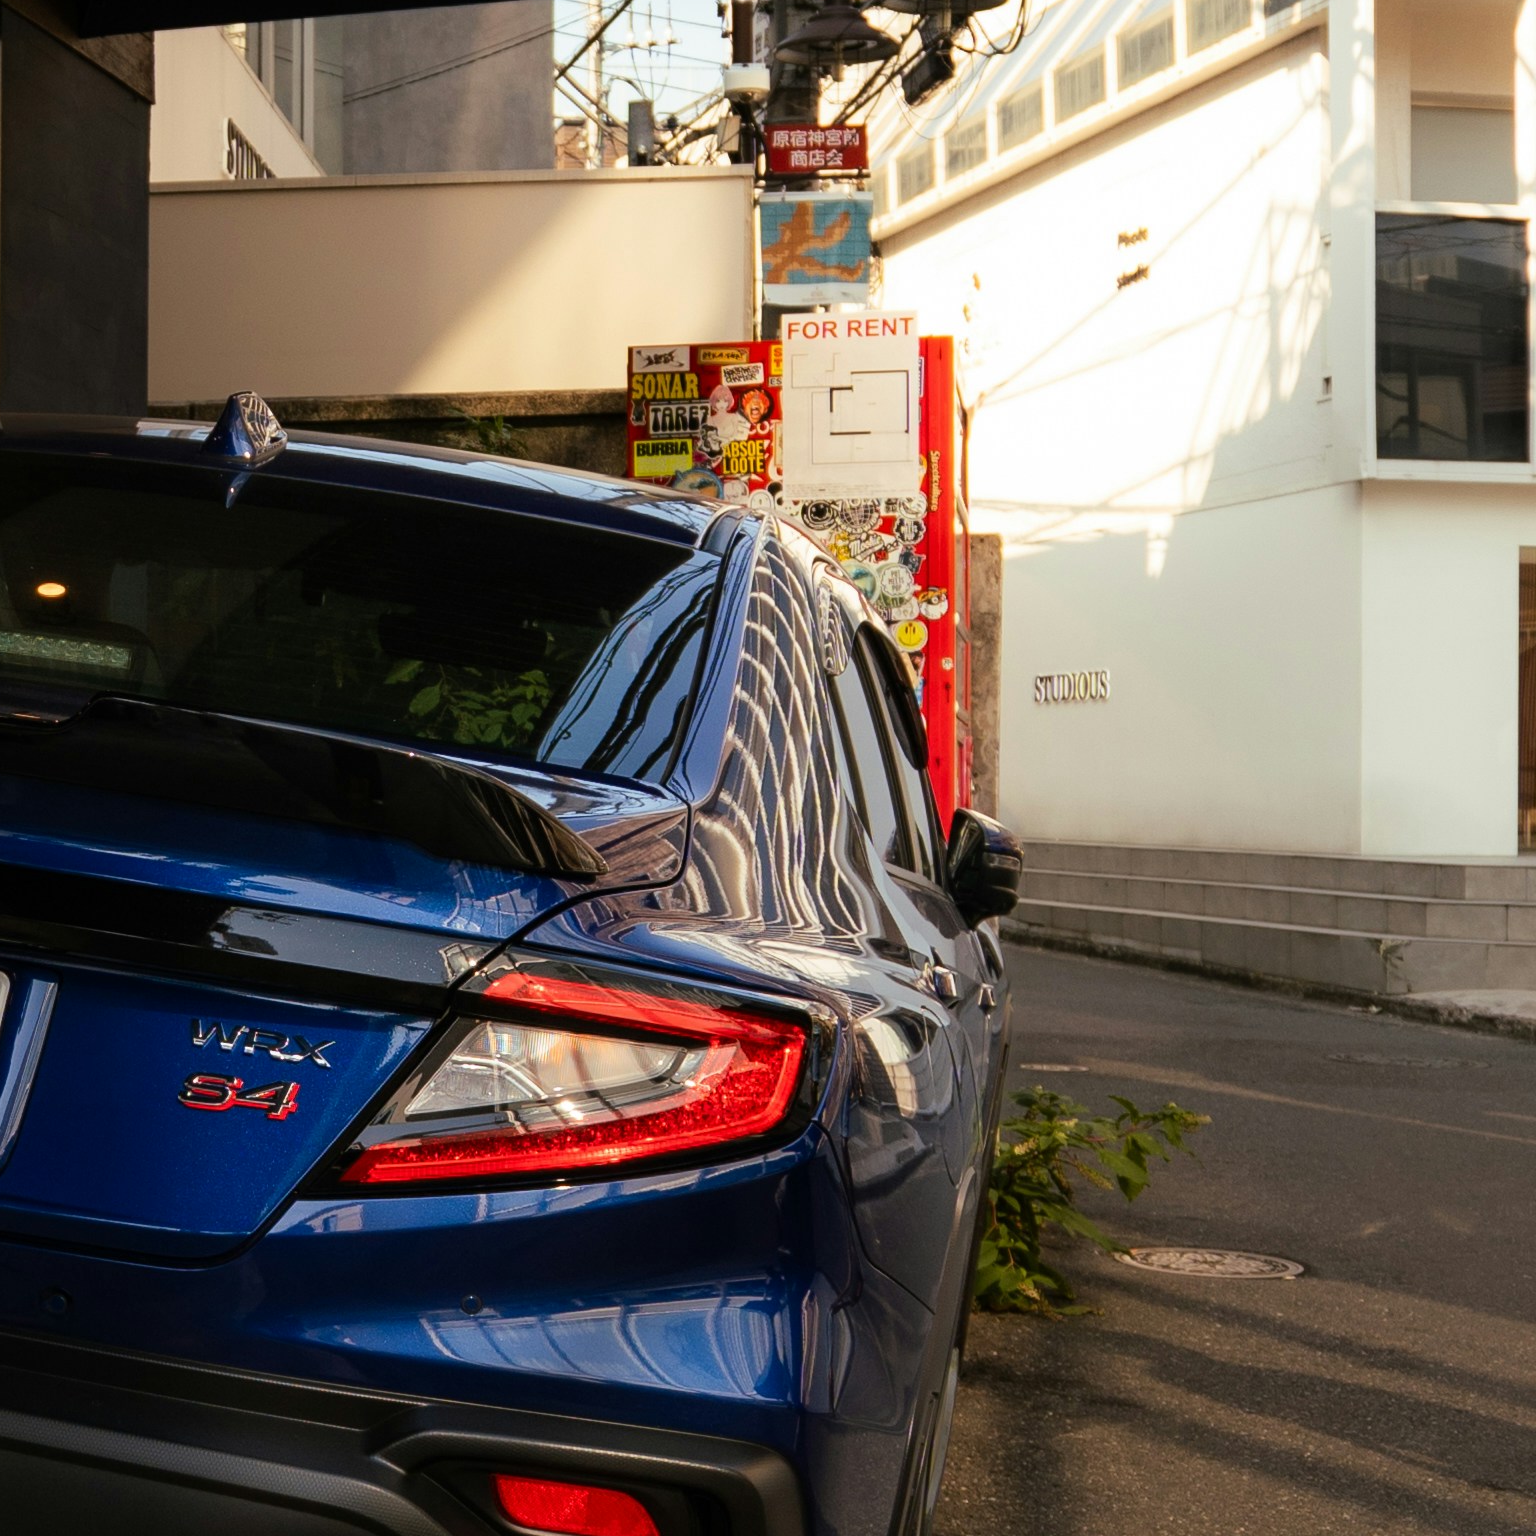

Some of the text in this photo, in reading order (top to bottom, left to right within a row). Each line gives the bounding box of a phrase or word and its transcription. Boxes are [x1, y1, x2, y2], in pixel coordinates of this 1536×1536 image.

[772, 129, 860, 149] 原宿神宮前
[790, 150, 844, 167] 商店会
[787, 317, 914, 340] FOR RENT
[631, 372, 700, 400] SONAR
[636, 441, 689, 457] BURBIA
[723, 440, 764, 457] ABSOE
[723, 456, 764, 474] LOOTE
[1034, 670, 1110, 703] STUDIOUS
[191, 1018, 336, 1068] WRX
[178, 1072, 301, 1121] S4
